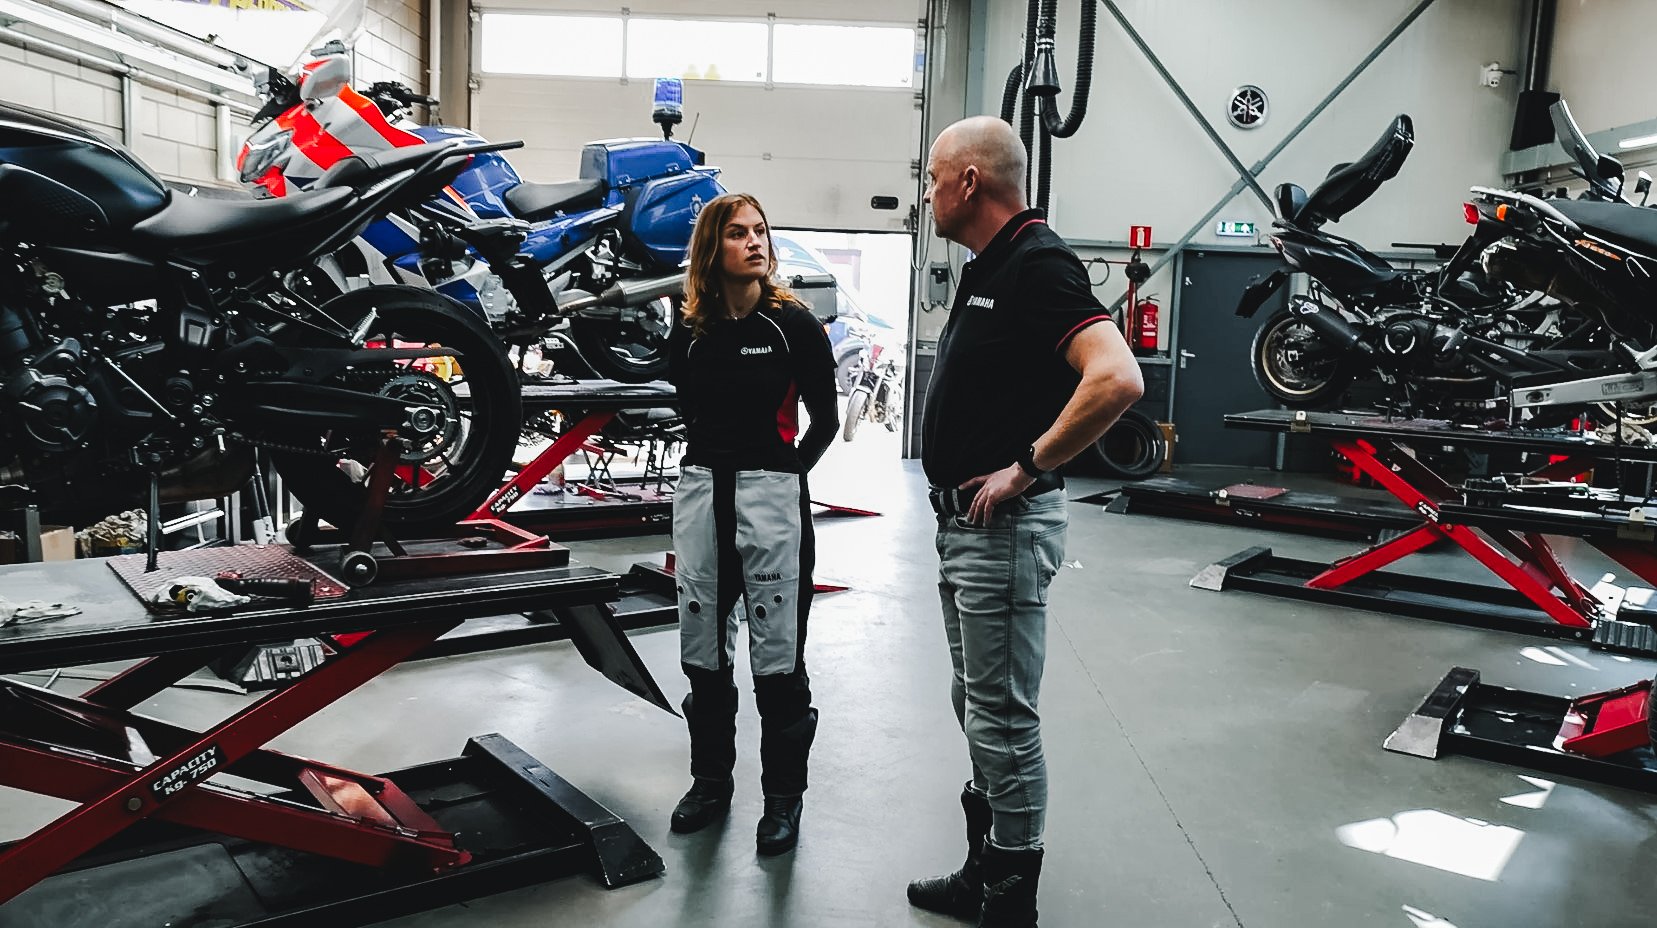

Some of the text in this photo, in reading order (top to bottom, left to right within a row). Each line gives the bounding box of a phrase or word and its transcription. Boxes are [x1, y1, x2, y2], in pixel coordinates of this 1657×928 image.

[748, 345, 773, 355] YAMAHA
[753, 572, 781, 582] YAMAHA
[153, 746, 216, 791] CAPACITY
[190, 757, 217, 779] 750
